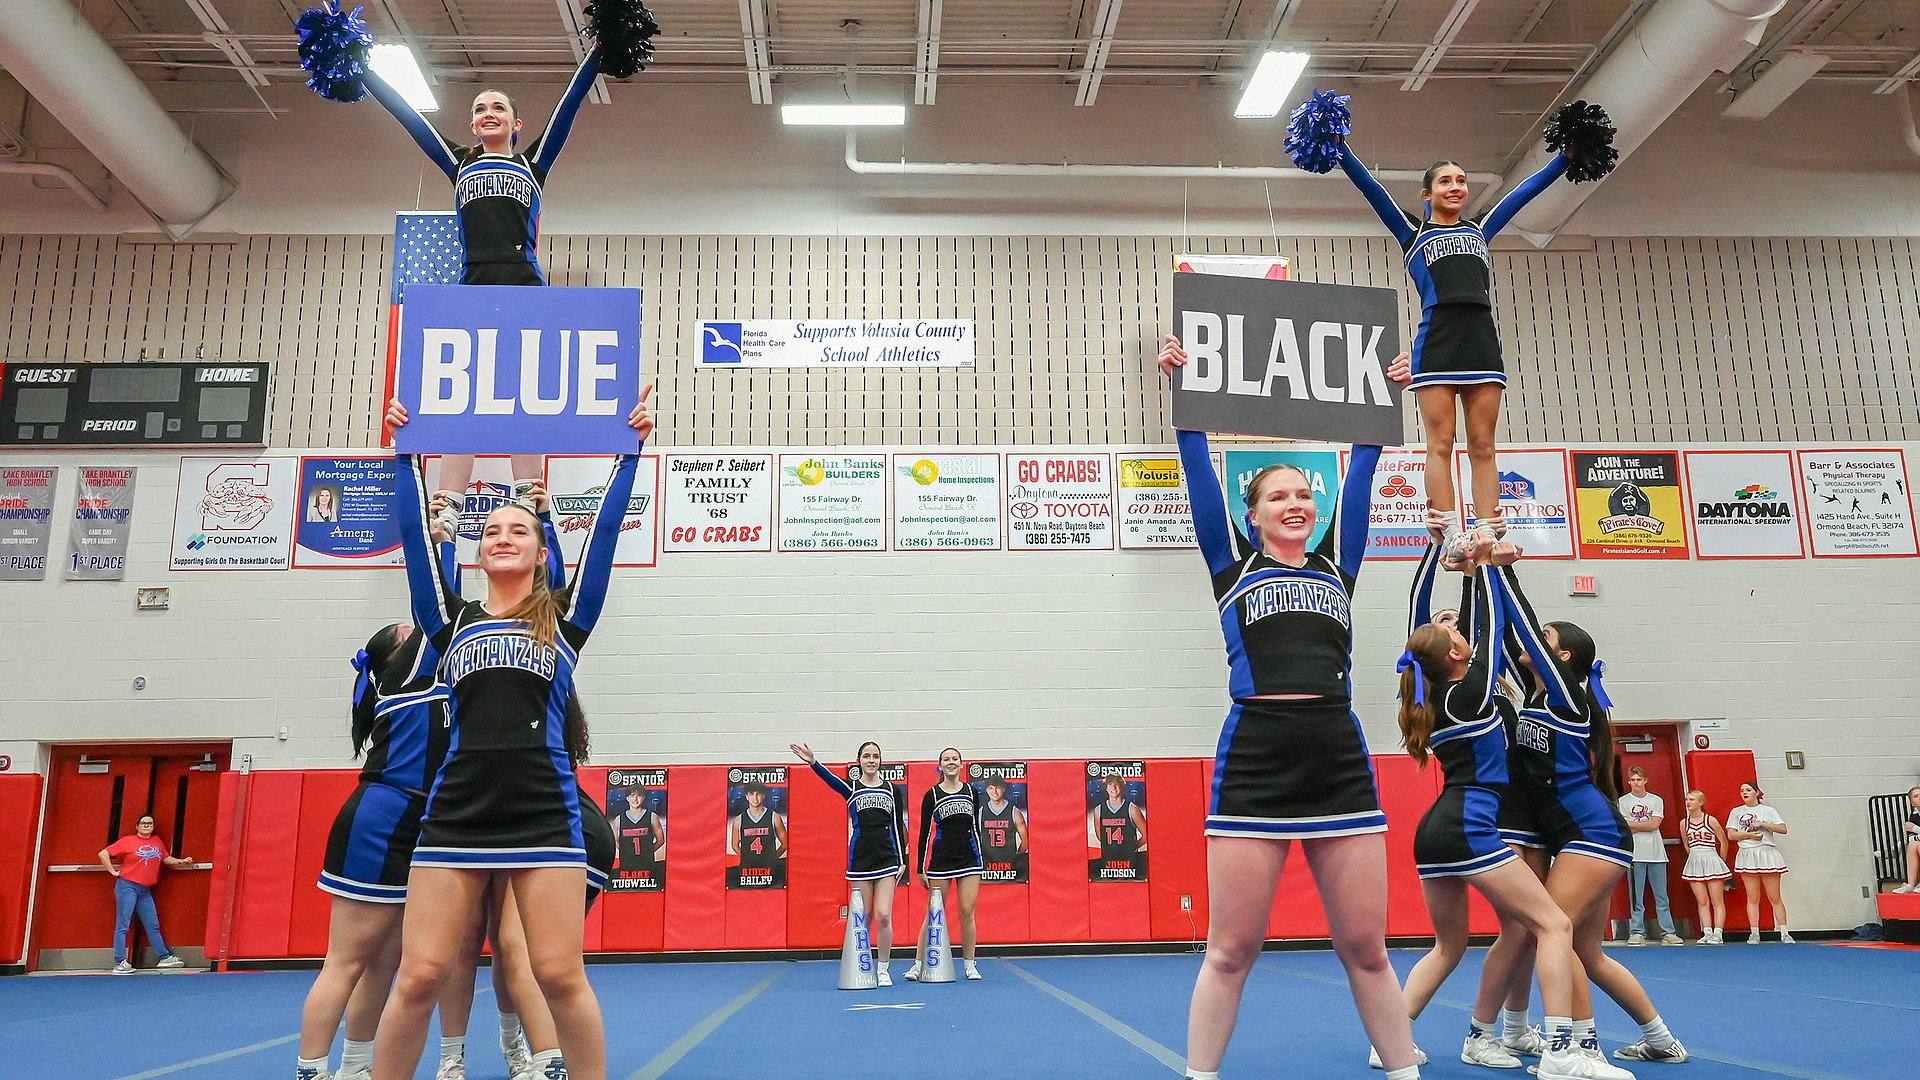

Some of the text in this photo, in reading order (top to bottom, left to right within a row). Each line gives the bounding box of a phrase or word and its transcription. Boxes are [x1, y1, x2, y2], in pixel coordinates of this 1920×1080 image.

[459, 173, 531, 209] MATANZAS
[743, 329, 768, 337] Florida
[794, 322, 966, 343] Supports Volusia County
[743, 339, 786, 347] Health Care
[742, 350, 762, 358] Plans
[820, 346, 941, 363] School Athletics
[1180, 310, 1394, 407] BLACK
[14, 368, 255, 383] GUEST HOME
[418, 328, 619, 416] BLUE
[83, 419, 138, 432] PERIOD
[333, 460, 384, 469] Your Local
[672, 459, 766, 474] Stephen P. Seibert
[805, 458, 884, 469] John Banks
[1593, 456, 1641, 469] JOIN THE
[1809, 460, 1896, 470] Barr & Associates
[3, 470, 55, 479] LAKE BRANTLEY
[82, 470, 133, 479] LAKE BRANTLEY
[315, 470, 395, 480] Mortgage Exper
[825, 470, 880, 479] BUILDERS
[1018, 460, 1101, 483] GO CRABS!
[1135, 470, 1180, 481] Volusia
[1587, 465, 1665, 482] ADVENTURE!
[1822, 471, 1886, 480] Physical Therapy
[7, 479, 49, 487] HIGH SCHOOL
[86, 479, 127, 487] HIGH SCHOOL
[684, 477, 753, 489] FAMILY
[938, 476, 995, 485] Home Inspections
[687, 492, 749, 504] TRUST
[918, 494, 978, 503] 155 Fairway Dr.
[1012, 484, 1059, 503] Daytona
[1135, 493, 1160, 502] (386)
[0, 499, 29, 509] PRIDE
[78, 499, 108, 509] PRIDE
[802, 495, 863, 504] 155 Fairway Dr.
[75, 508, 130, 520] CHAMPIONSHIP
[706, 508, 728, 519] '68
[1043, 503, 1110, 518] TOYOTA
[1127, 503, 1150, 515] GO
[1524, 502, 1565, 517] PROS
[1697, 502, 1791, 518] DAYTONA
[783, 516, 881, 526] JohnInspection@aol.com
[899, 515, 996, 525] JohnInspection@aol.com
[1816, 513, 1835, 521] 1425
[1836, 512, 1855, 520] Hand
[1874, 512, 1893, 520] Suite
[1894, 512, 1901, 520] H
[1013, 521, 1106, 532] 451 N. Nova Road, Daytona Beach
[1605, 517, 1658, 531] Pirate's Cove
[1816, 523, 1846, 531] Ormond
[1846, 523, 1871, 531] Beach,
[1882, 522, 1904, 530] 32174
[330, 525, 375, 538] Ameris
[671, 525, 762, 543] GO CRABS
[207, 536, 278, 544] FOUNDATION
[783, 538, 878, 548] (386) 566-0963
[900, 537, 994, 547] (386) 566-0963
[1025, 532, 1091, 545] (386) 255-7475
[1602, 547, 1661, 555] PiratesIslandGolf.com
[10, 556, 45, 569] PLACE
[89, 556, 124, 569] PLACE
[174, 557, 286, 566] Supporting Girls On The Basketball Court
[1574, 576, 1594, 592] EXIT
[1245, 581, 1350, 630] MATANZAS
[450, 635, 555, 688] MATANZAS
[743, 771, 785, 784] SENIOR
[983, 767, 1025, 779] SENIOR
[1101, 766, 1143, 779] SENIOR
[622, 773, 666, 787] SENIOR
[988, 829, 1006, 847] 13
[1105, 827, 1124, 845] 14
[632, 837, 641, 855] 1
[750, 837, 763, 855] 4
[986, 862, 1012, 870] JOHN
[1105, 861, 1130, 869] JOHN
[620, 870, 650, 879] BLAKE
[741, 868, 771, 876] AIDEN
[1099, 869, 1137, 878] HUDSON
[612, 879, 657, 889] TUGWELL
[740, 875, 773, 886] BAILEY
